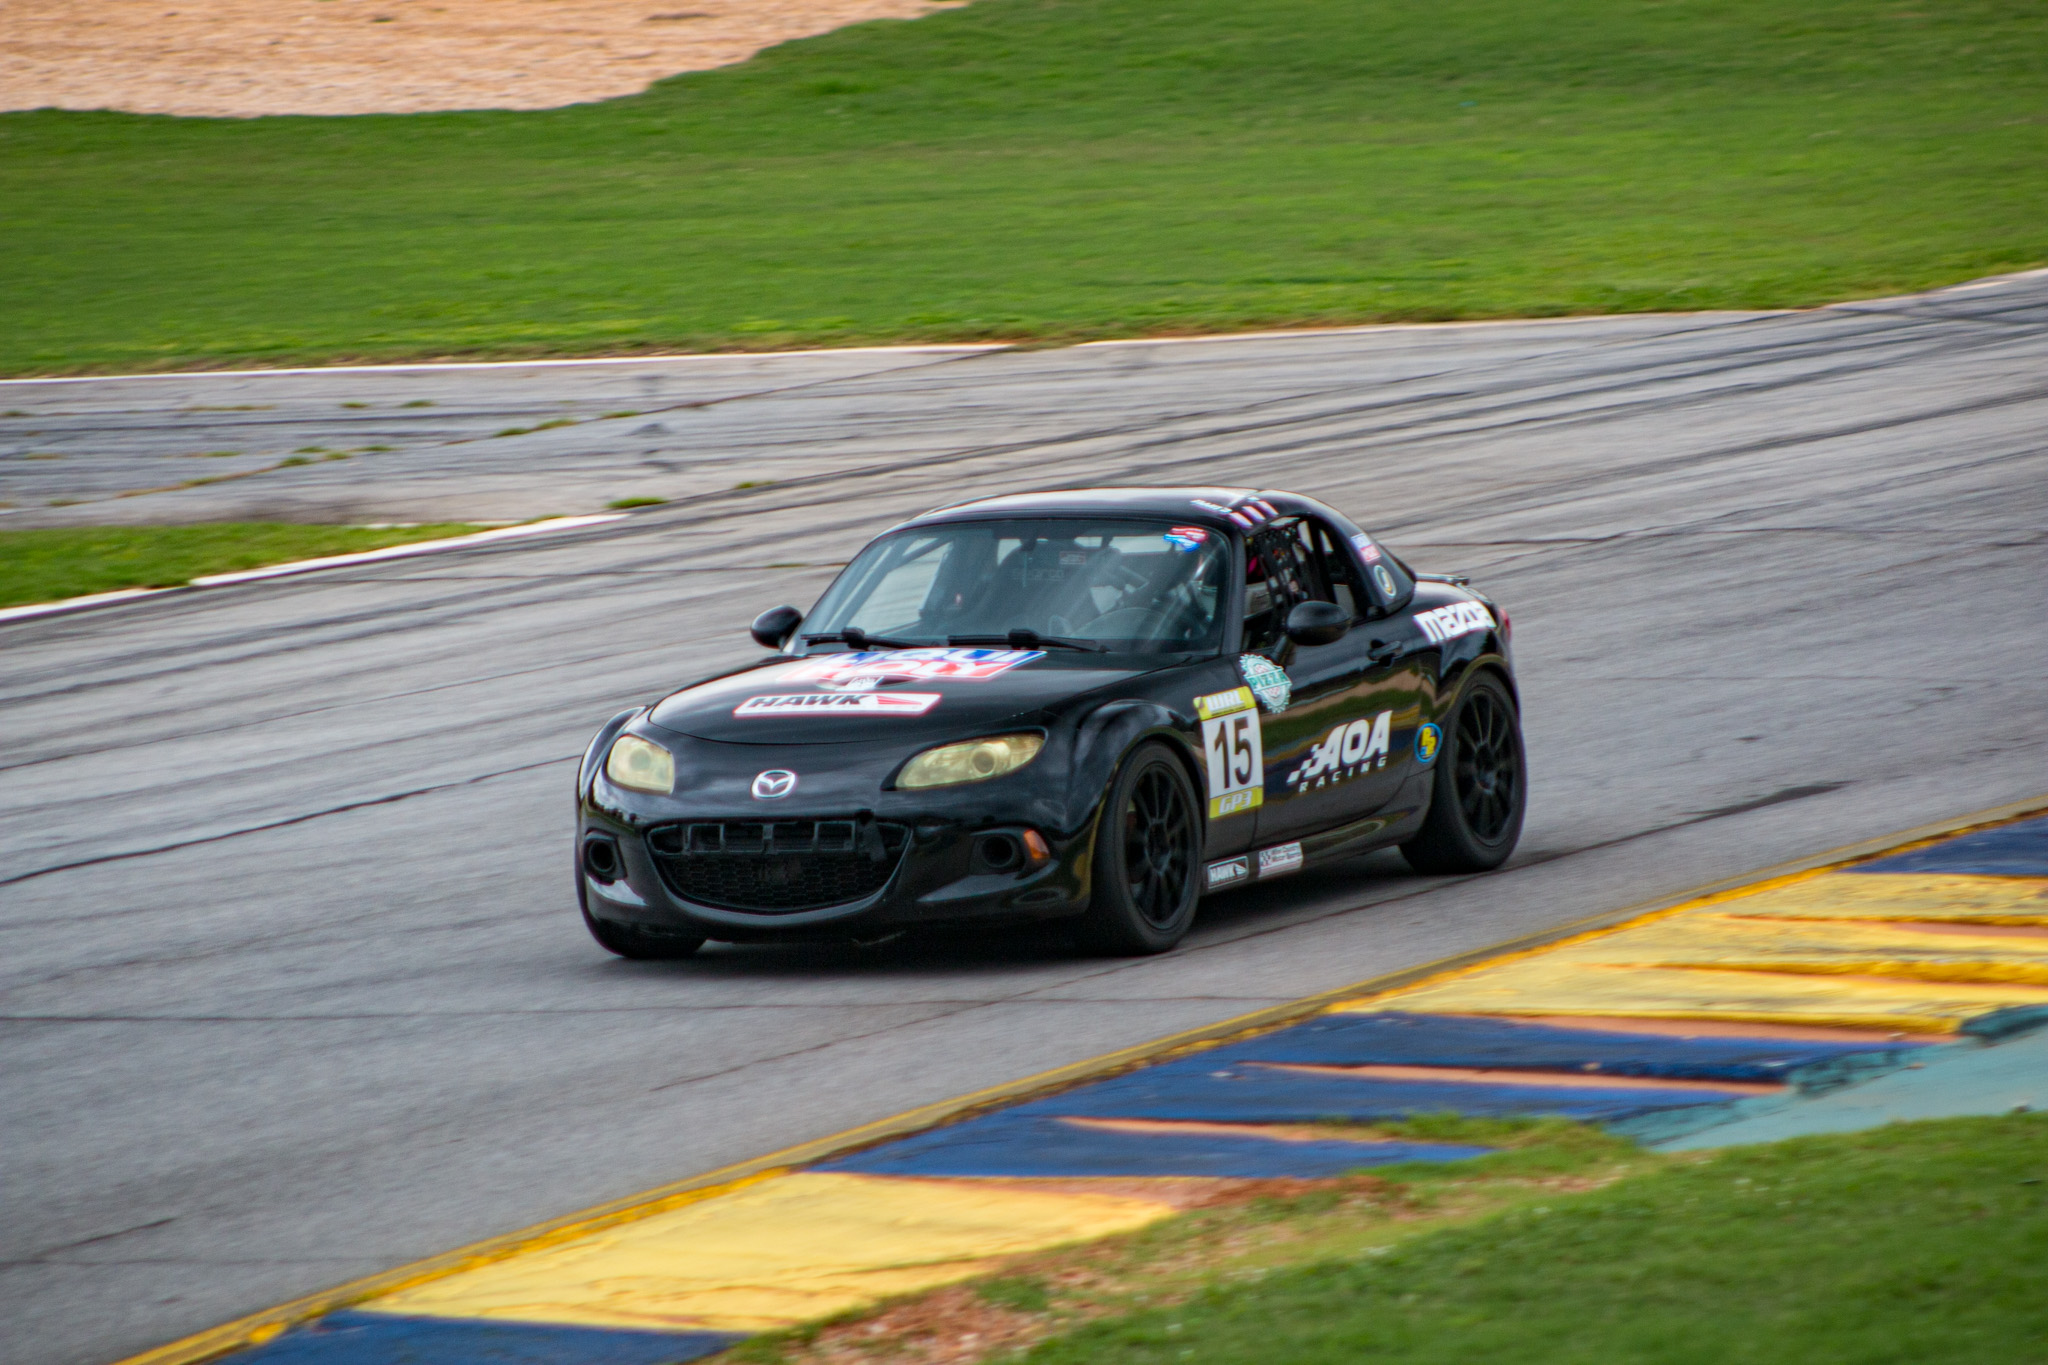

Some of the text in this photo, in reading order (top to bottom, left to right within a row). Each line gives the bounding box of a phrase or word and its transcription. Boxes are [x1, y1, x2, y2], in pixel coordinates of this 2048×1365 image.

[1248, 670, 1289, 690] PIZZA
[747, 694, 870, 707] HAWK
[1206, 690, 1244, 711] WRL
[1214, 716, 1252, 790] 15
[1303, 709, 1393, 778] AOA
[1298, 755, 1388, 793] RACING
[1218, 790, 1253, 815] GP3
[1209, 862, 1236, 883] HAWK
